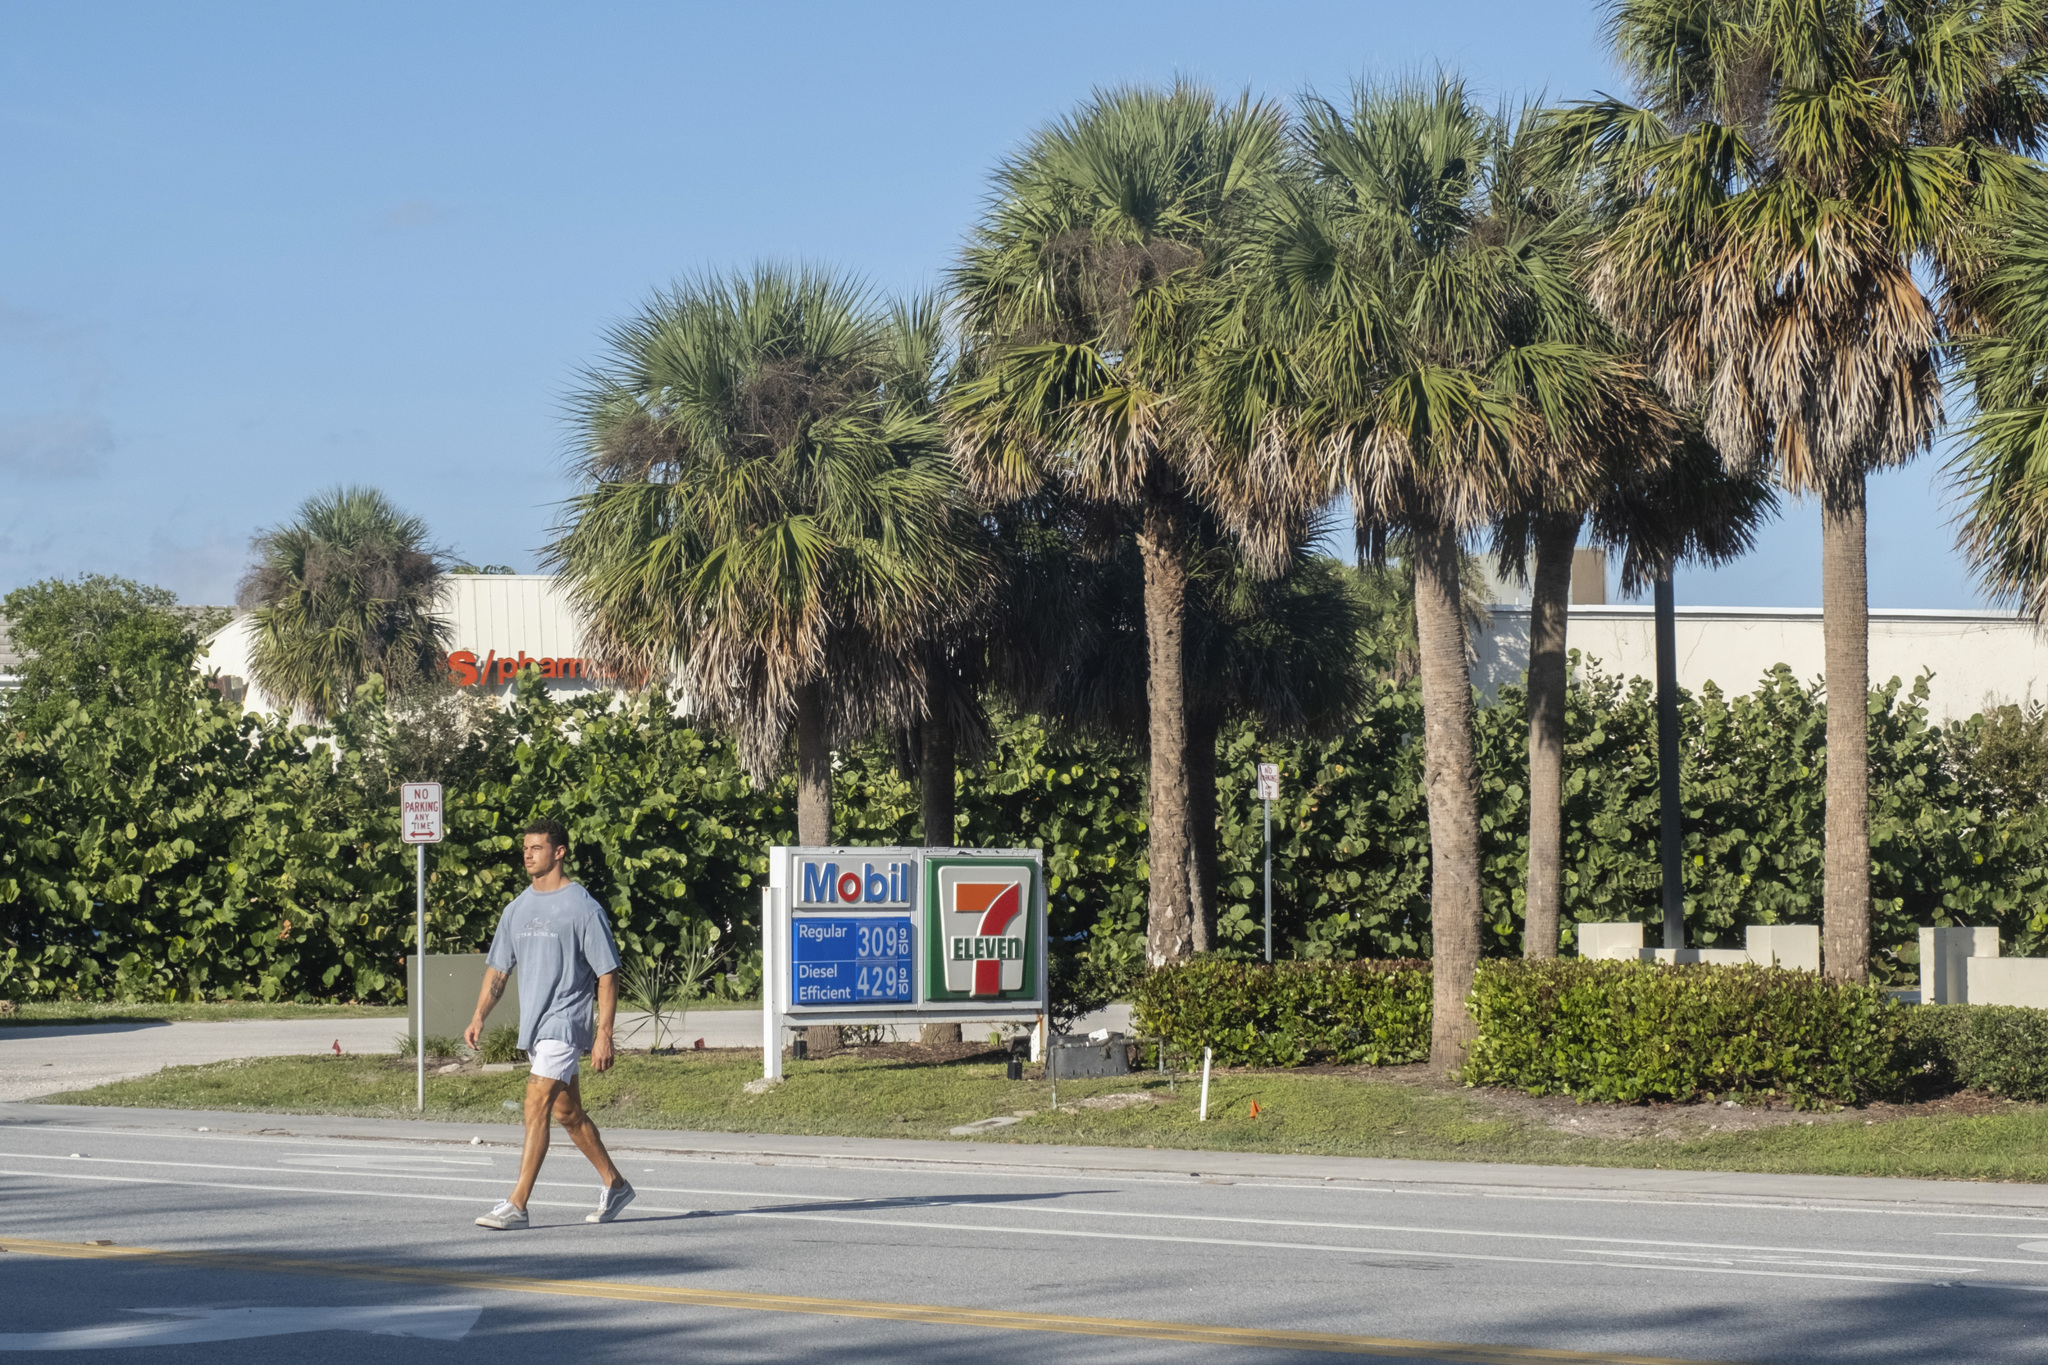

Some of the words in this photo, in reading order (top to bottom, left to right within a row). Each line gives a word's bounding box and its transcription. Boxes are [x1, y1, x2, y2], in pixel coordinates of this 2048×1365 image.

[414, 788, 428, 799] NO
[405, 801, 438, 812] PARKING
[413, 822, 431, 830] TIME
[802, 862, 908, 902] Mobil
[799, 923, 847, 942] Regular
[858, 926, 897, 957] 309
[953, 881, 1019, 996] 7
[799, 963, 838, 979] Diesel
[857, 966, 897, 996] 429
[799, 985, 851, 1000] Efficient
